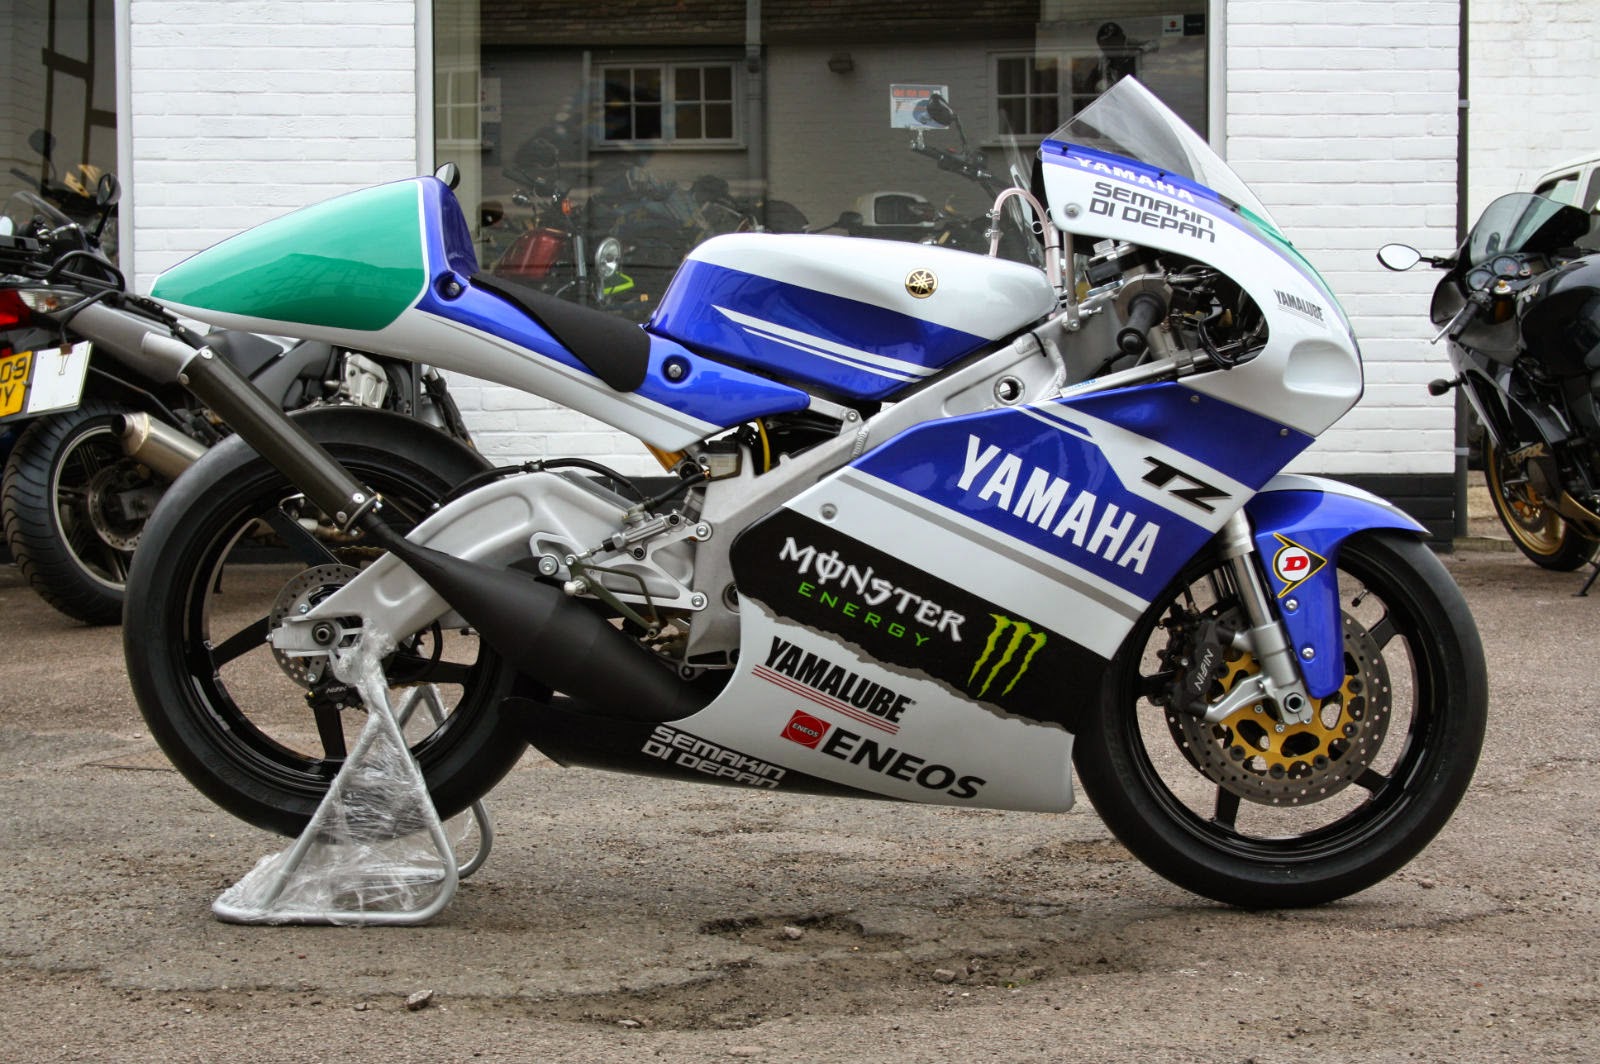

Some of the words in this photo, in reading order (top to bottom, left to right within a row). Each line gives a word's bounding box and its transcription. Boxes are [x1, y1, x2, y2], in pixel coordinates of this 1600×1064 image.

[1073, 156, 1195, 203] YAMAHA
[1089, 197, 1116, 217] DI
[1122, 206, 1216, 243] DEPAN
[1092, 181, 1214, 229] SEMAKIN
[1273, 289, 1324, 322] YAMALUBE
[957, 433, 1161, 576] YAMAHA
[1142, 455, 1233, 513] TZ
[778, 536, 967, 643] MONSTER
[797, 581, 931, 648] ENERGY
[1193, 647, 1214, 691] NISSIN
[650, 725, 787, 781] SEMAKIN
[791, 722, 820, 738] ENEOS
[641, 739, 674, 761] DI
[675, 752, 780, 789] DEPAN
[821, 726, 987, 800] ENEOS
